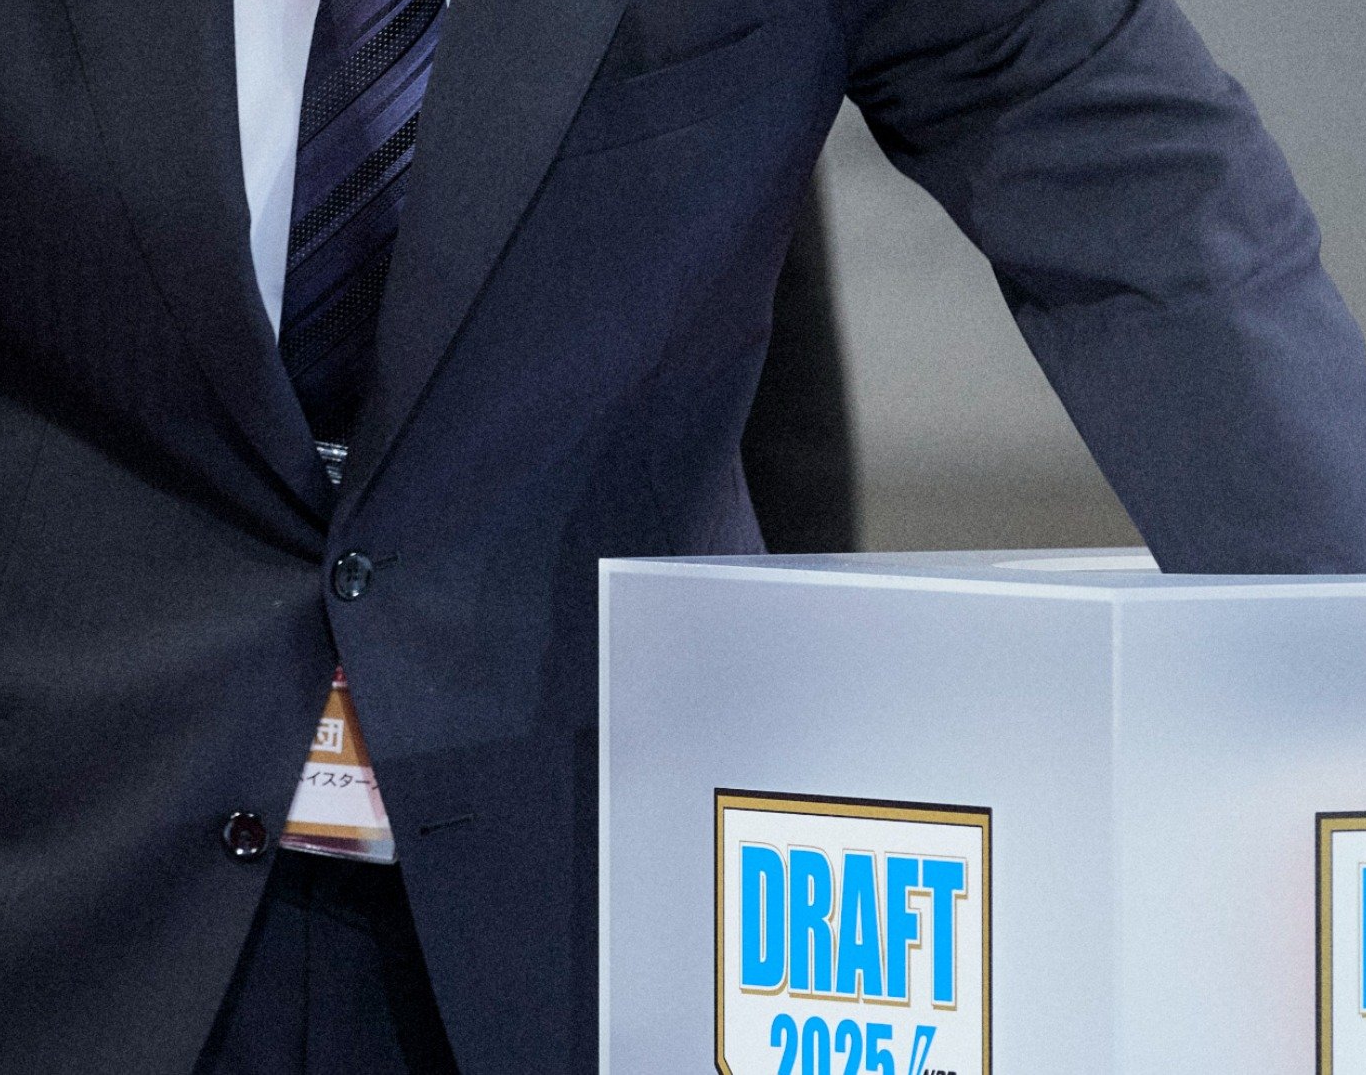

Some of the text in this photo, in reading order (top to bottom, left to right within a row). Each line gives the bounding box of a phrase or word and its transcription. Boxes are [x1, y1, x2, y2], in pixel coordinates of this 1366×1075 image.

[300, 771, 379, 791] イスター
[740, 842, 966, 1009] DRAFT
